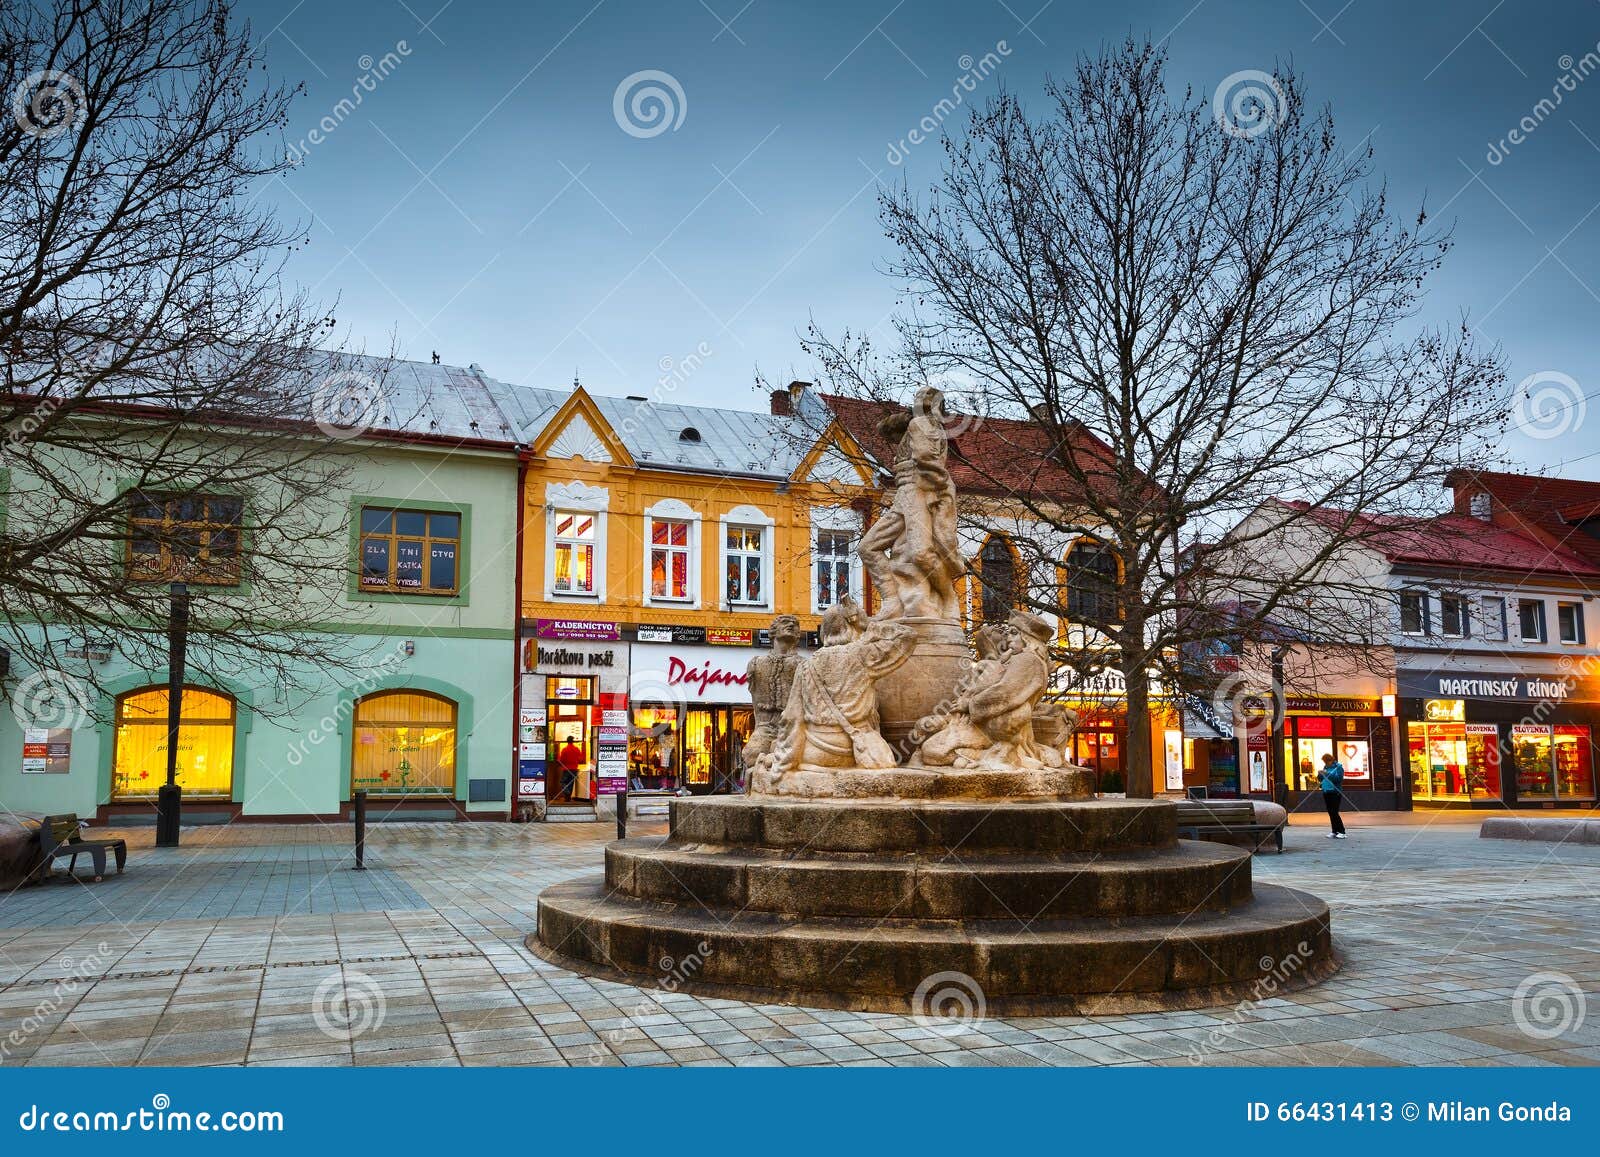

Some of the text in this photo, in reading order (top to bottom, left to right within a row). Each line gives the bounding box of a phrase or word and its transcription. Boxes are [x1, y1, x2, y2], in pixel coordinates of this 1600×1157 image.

[432, 550, 454, 559] CTVO
[588, 650, 614, 668] pasáž
[1439, 677, 1568, 698] MARTINSKÝ RÍNOK
[1466, 725, 1496, 733] SLOVENKA
[1513, 725, 1549, 734] SLOVENKA
